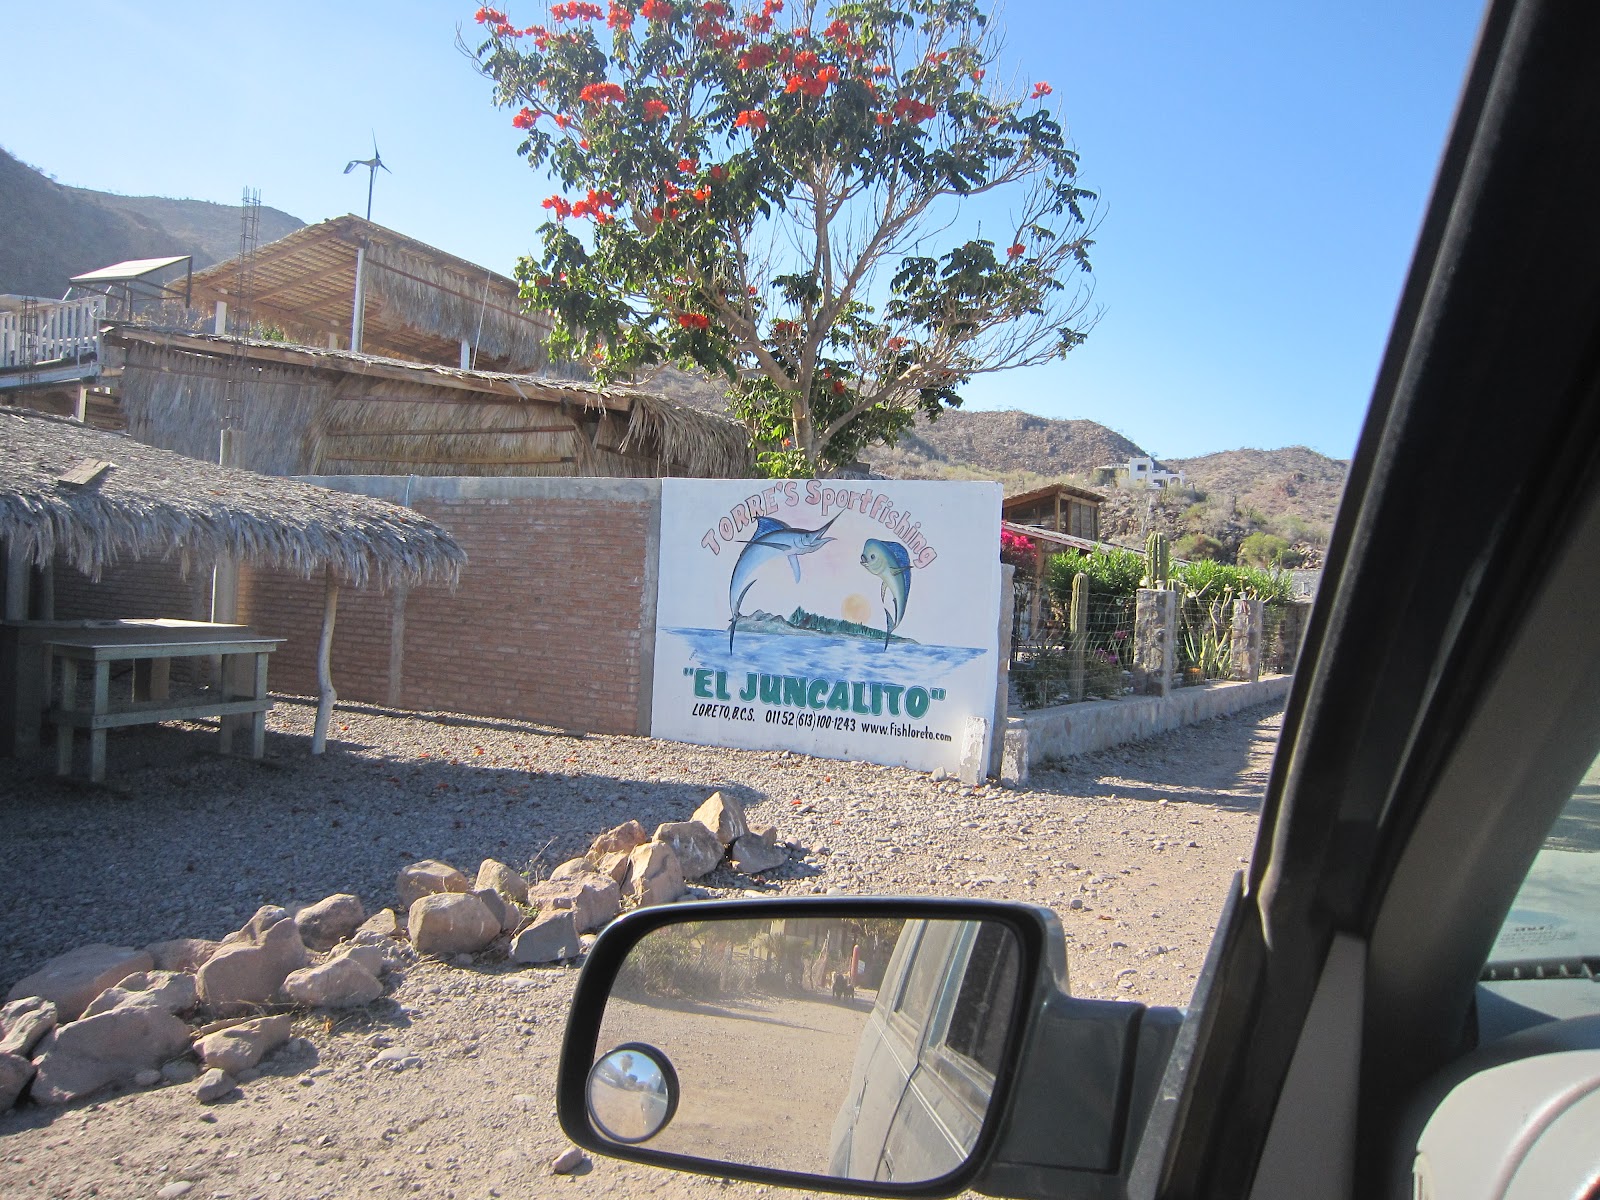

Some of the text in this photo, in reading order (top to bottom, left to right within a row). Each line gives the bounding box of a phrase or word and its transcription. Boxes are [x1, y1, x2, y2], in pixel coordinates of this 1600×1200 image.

[701, 480, 937, 569] TORRE'S Sportfishing
[861, 721, 952, 742] www.fishloreto.com
